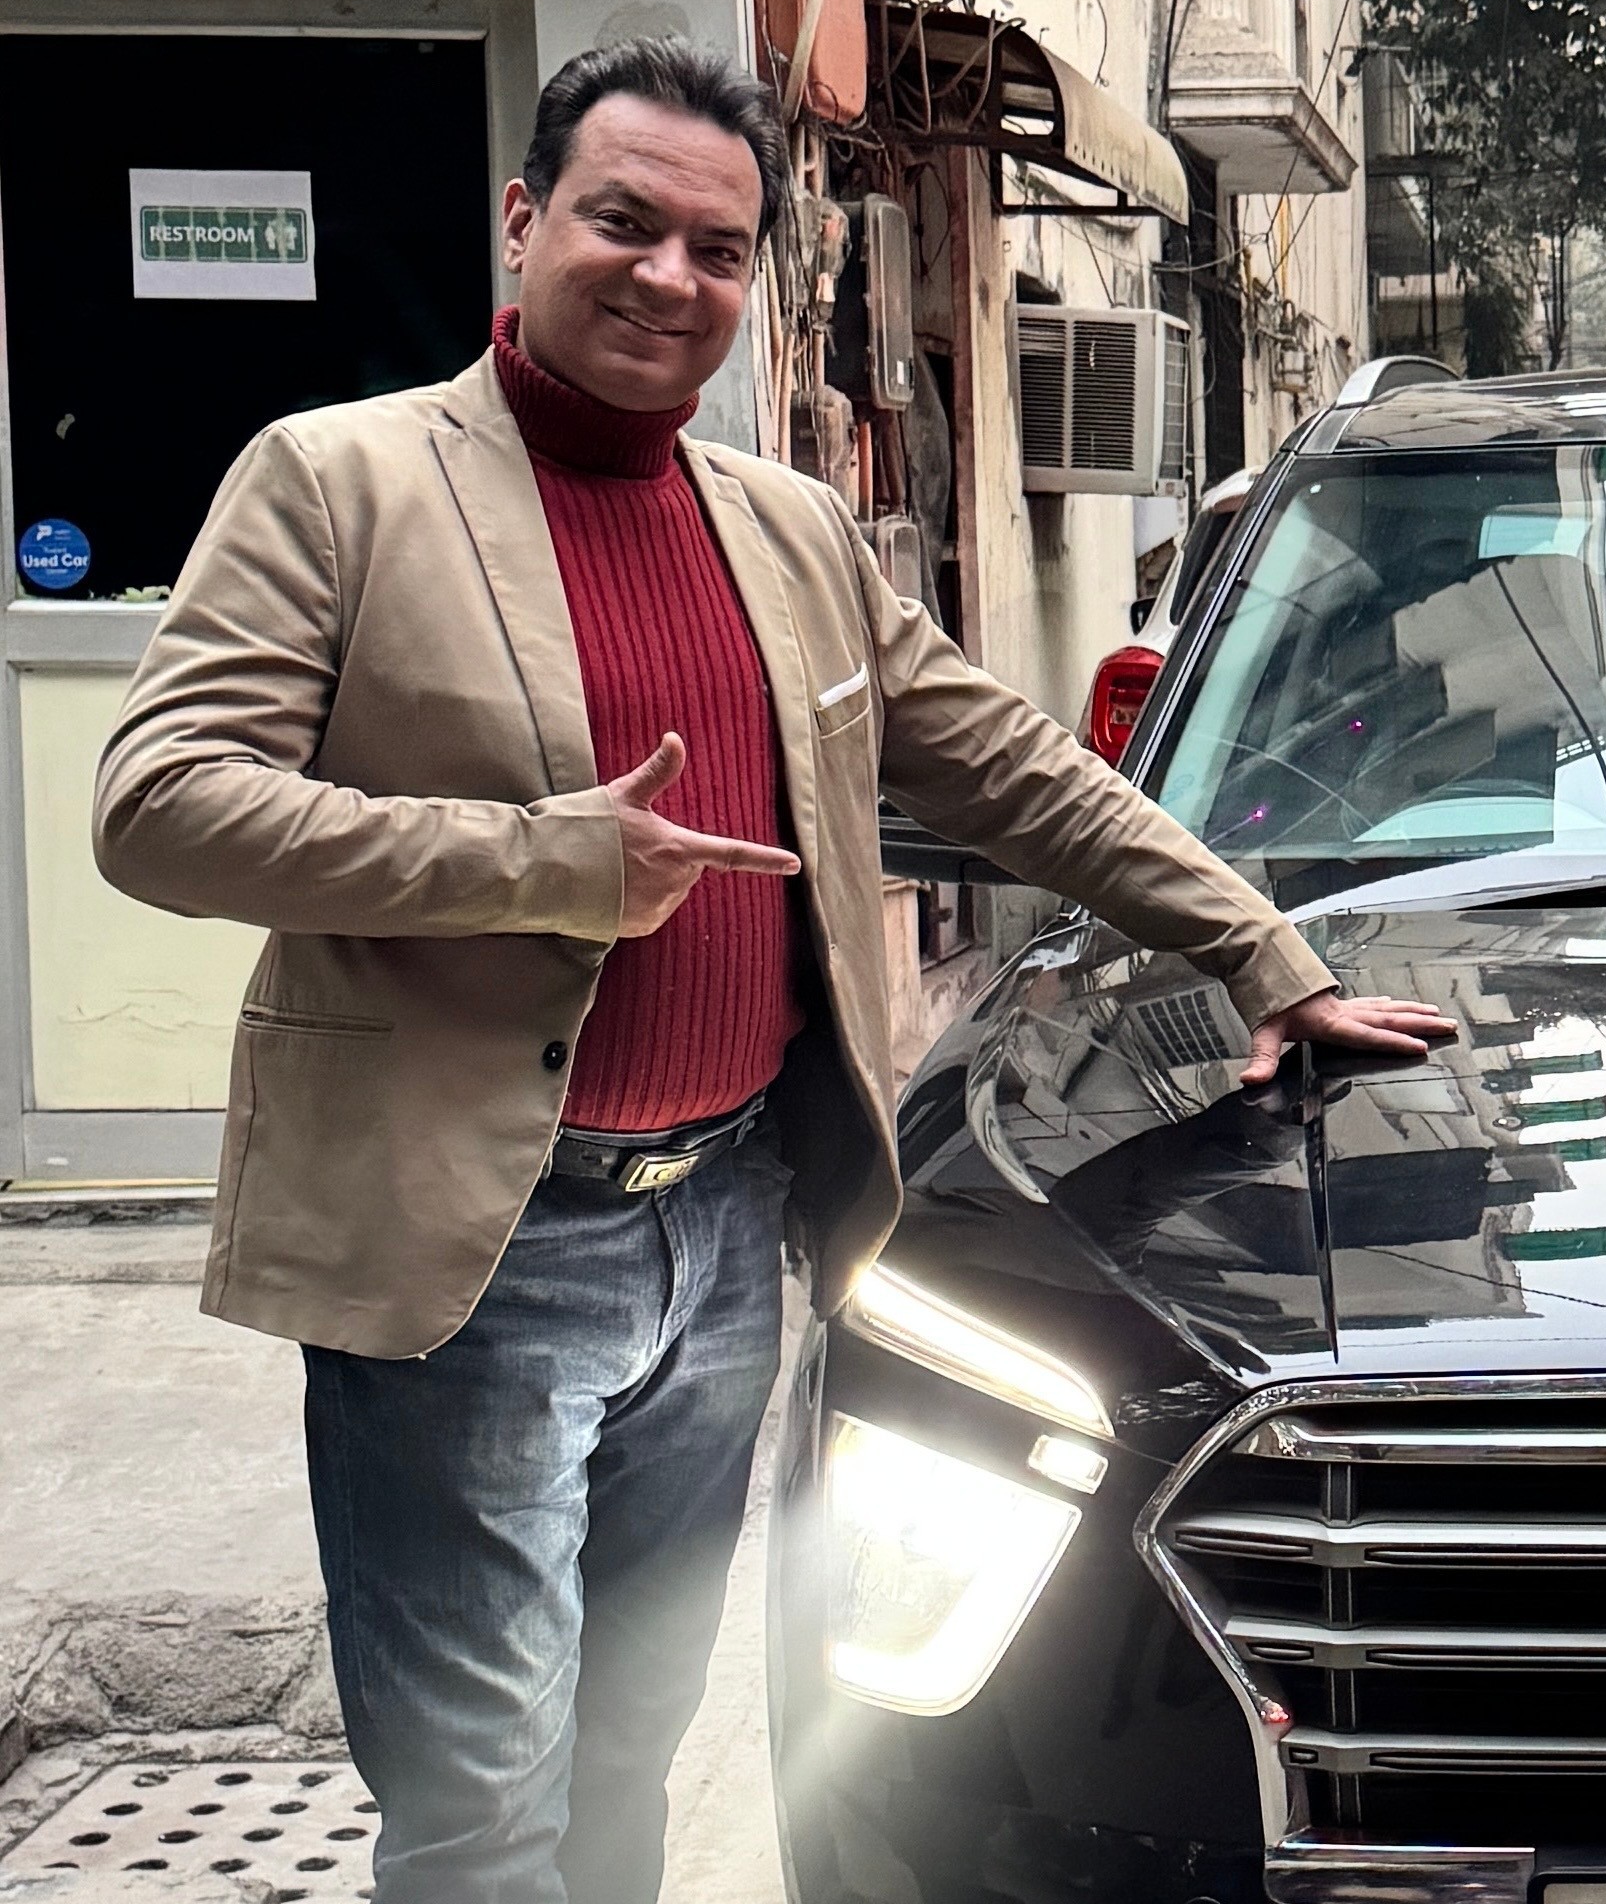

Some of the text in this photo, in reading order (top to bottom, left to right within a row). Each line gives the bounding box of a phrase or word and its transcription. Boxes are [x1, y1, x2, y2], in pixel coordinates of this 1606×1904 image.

[149, 225, 255, 243] RESTROOM
[23, 553, 89, 568] Used Car
